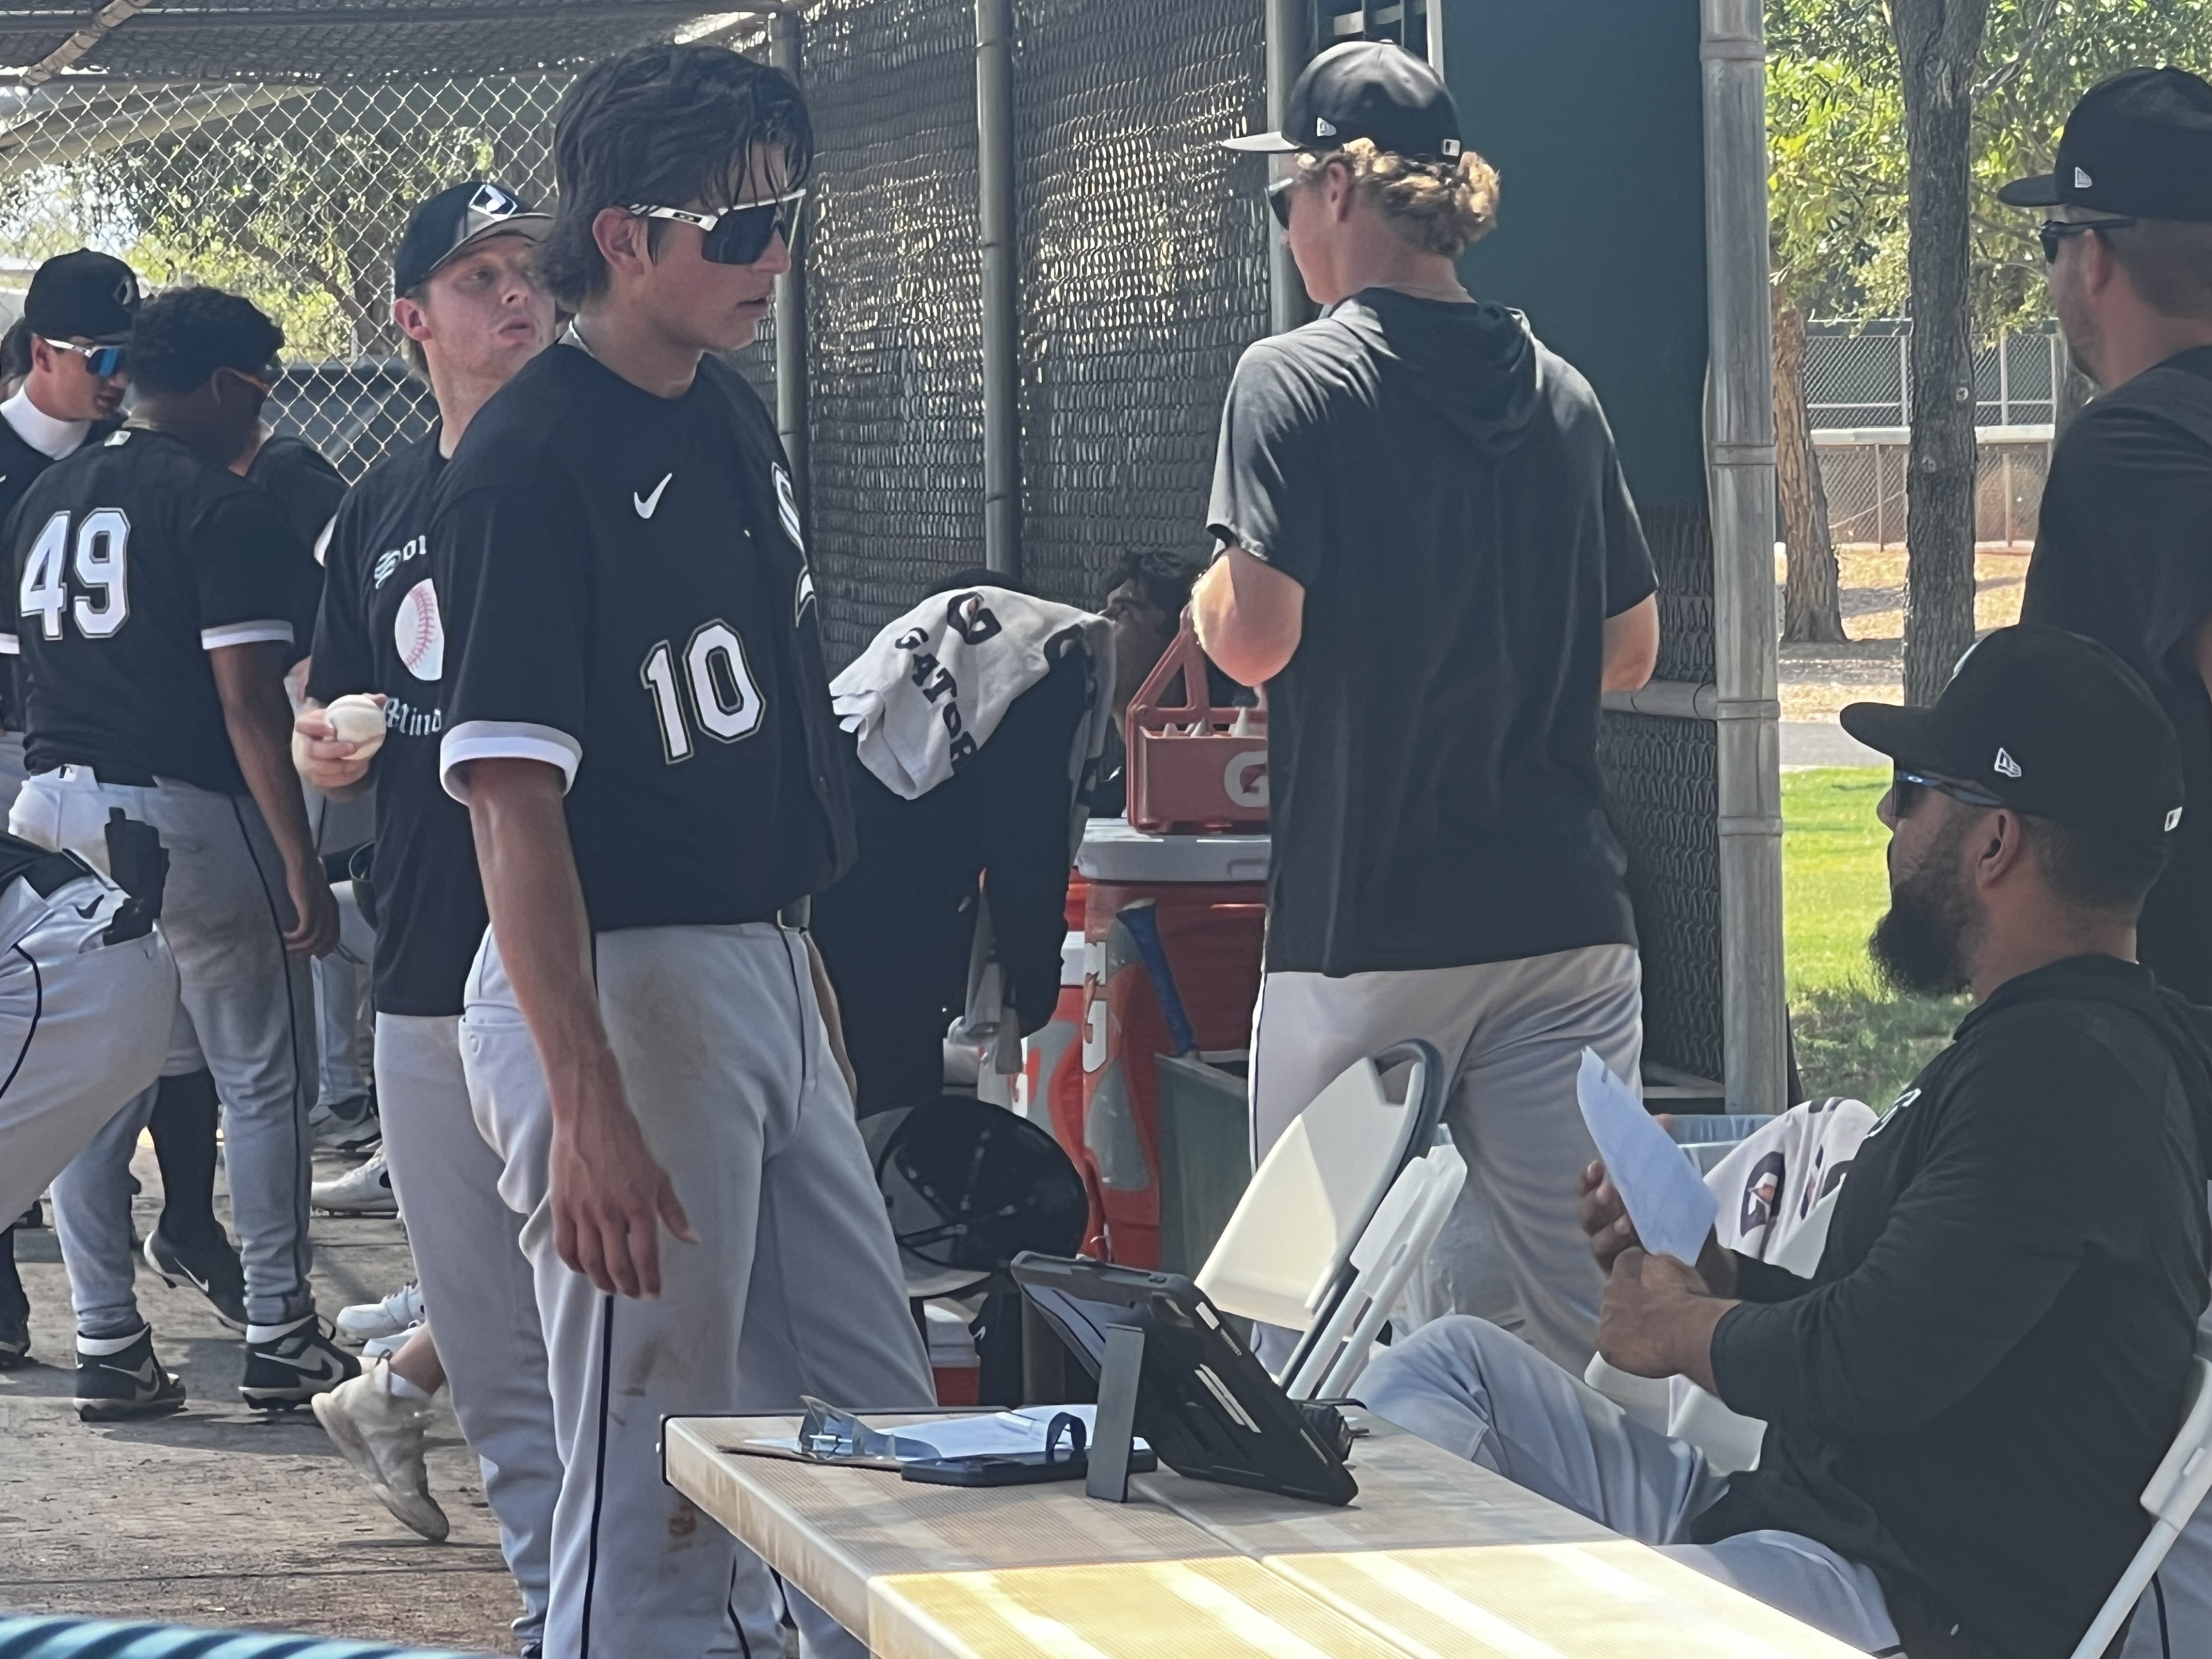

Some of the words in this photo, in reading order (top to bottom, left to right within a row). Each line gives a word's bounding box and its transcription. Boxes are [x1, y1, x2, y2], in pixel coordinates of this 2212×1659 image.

[20, 507, 131, 640] 49
[640, 618, 766, 765] 10
[1224, 750, 1269, 808] G
